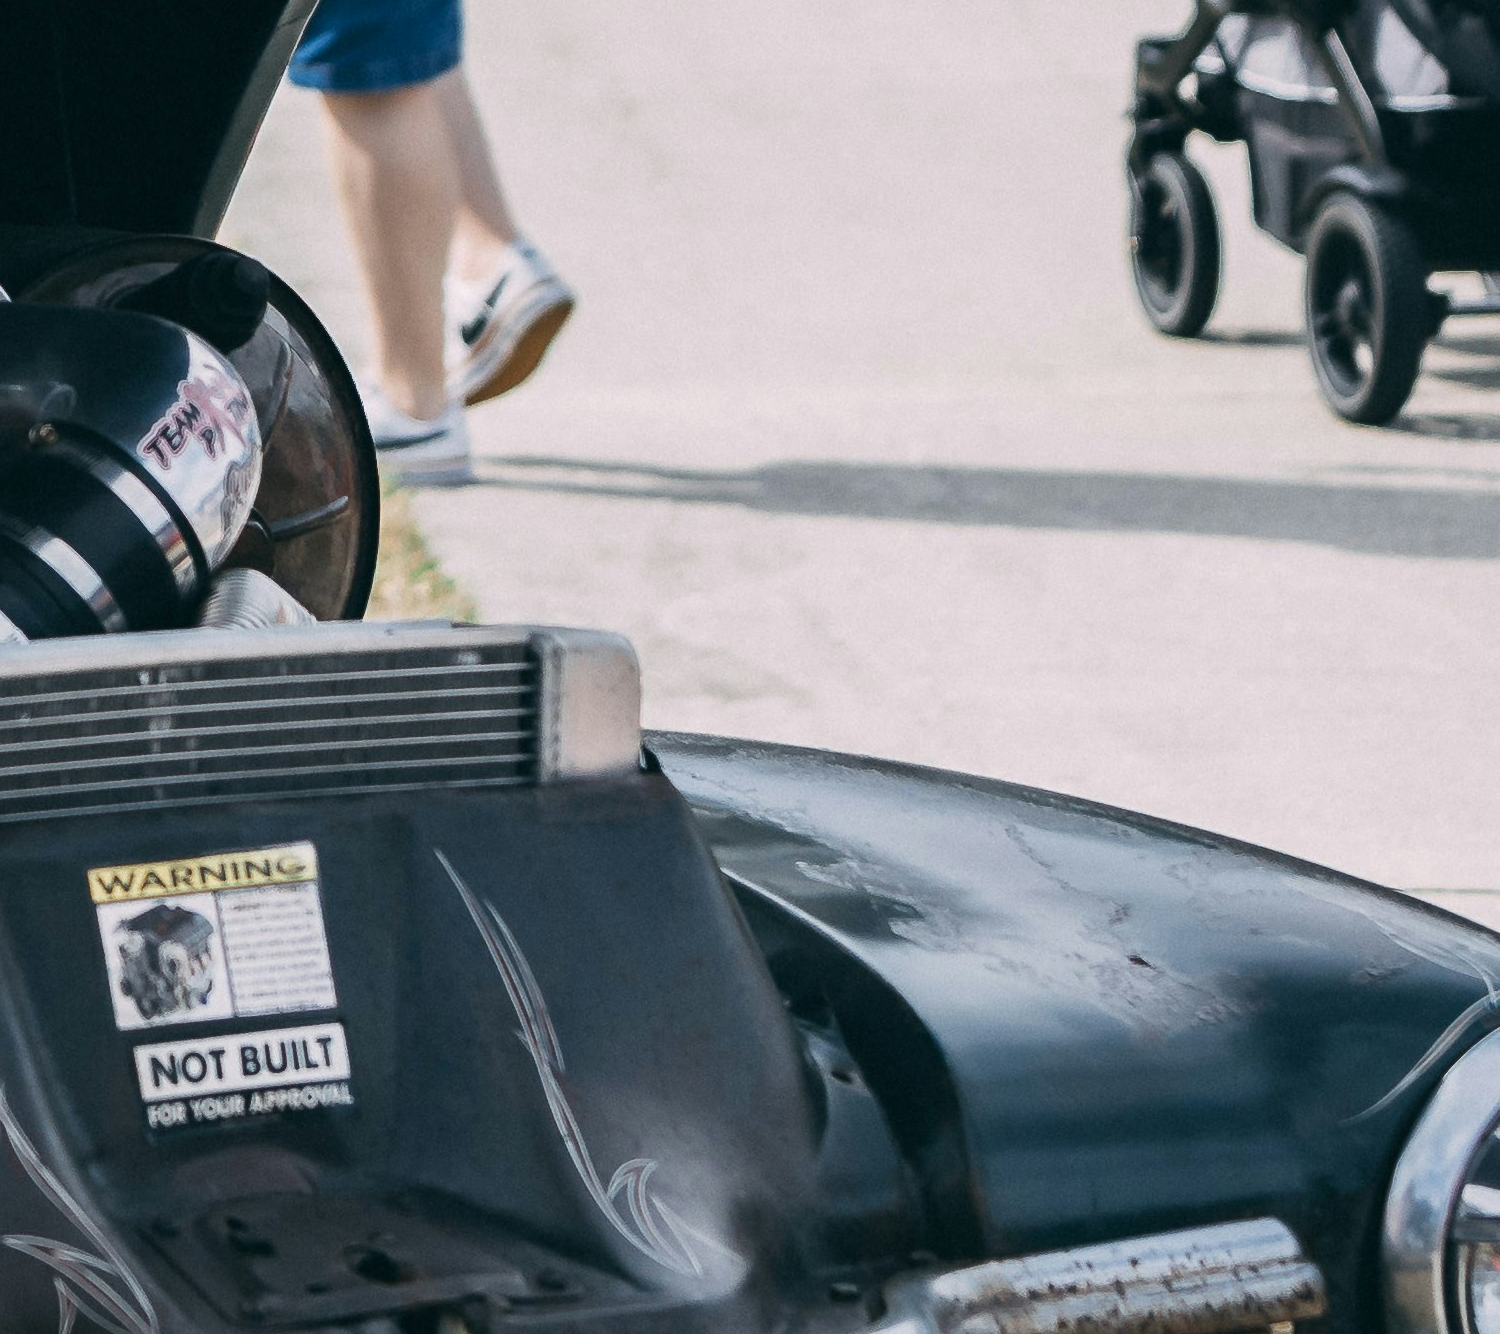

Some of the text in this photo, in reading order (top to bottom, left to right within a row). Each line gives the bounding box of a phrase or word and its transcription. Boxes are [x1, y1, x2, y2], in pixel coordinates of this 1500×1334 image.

[142, 399, 201, 465] TEAM
[96, 854, 307, 897] WARNING
[150, 1036, 332, 1088] NOT BUILT
